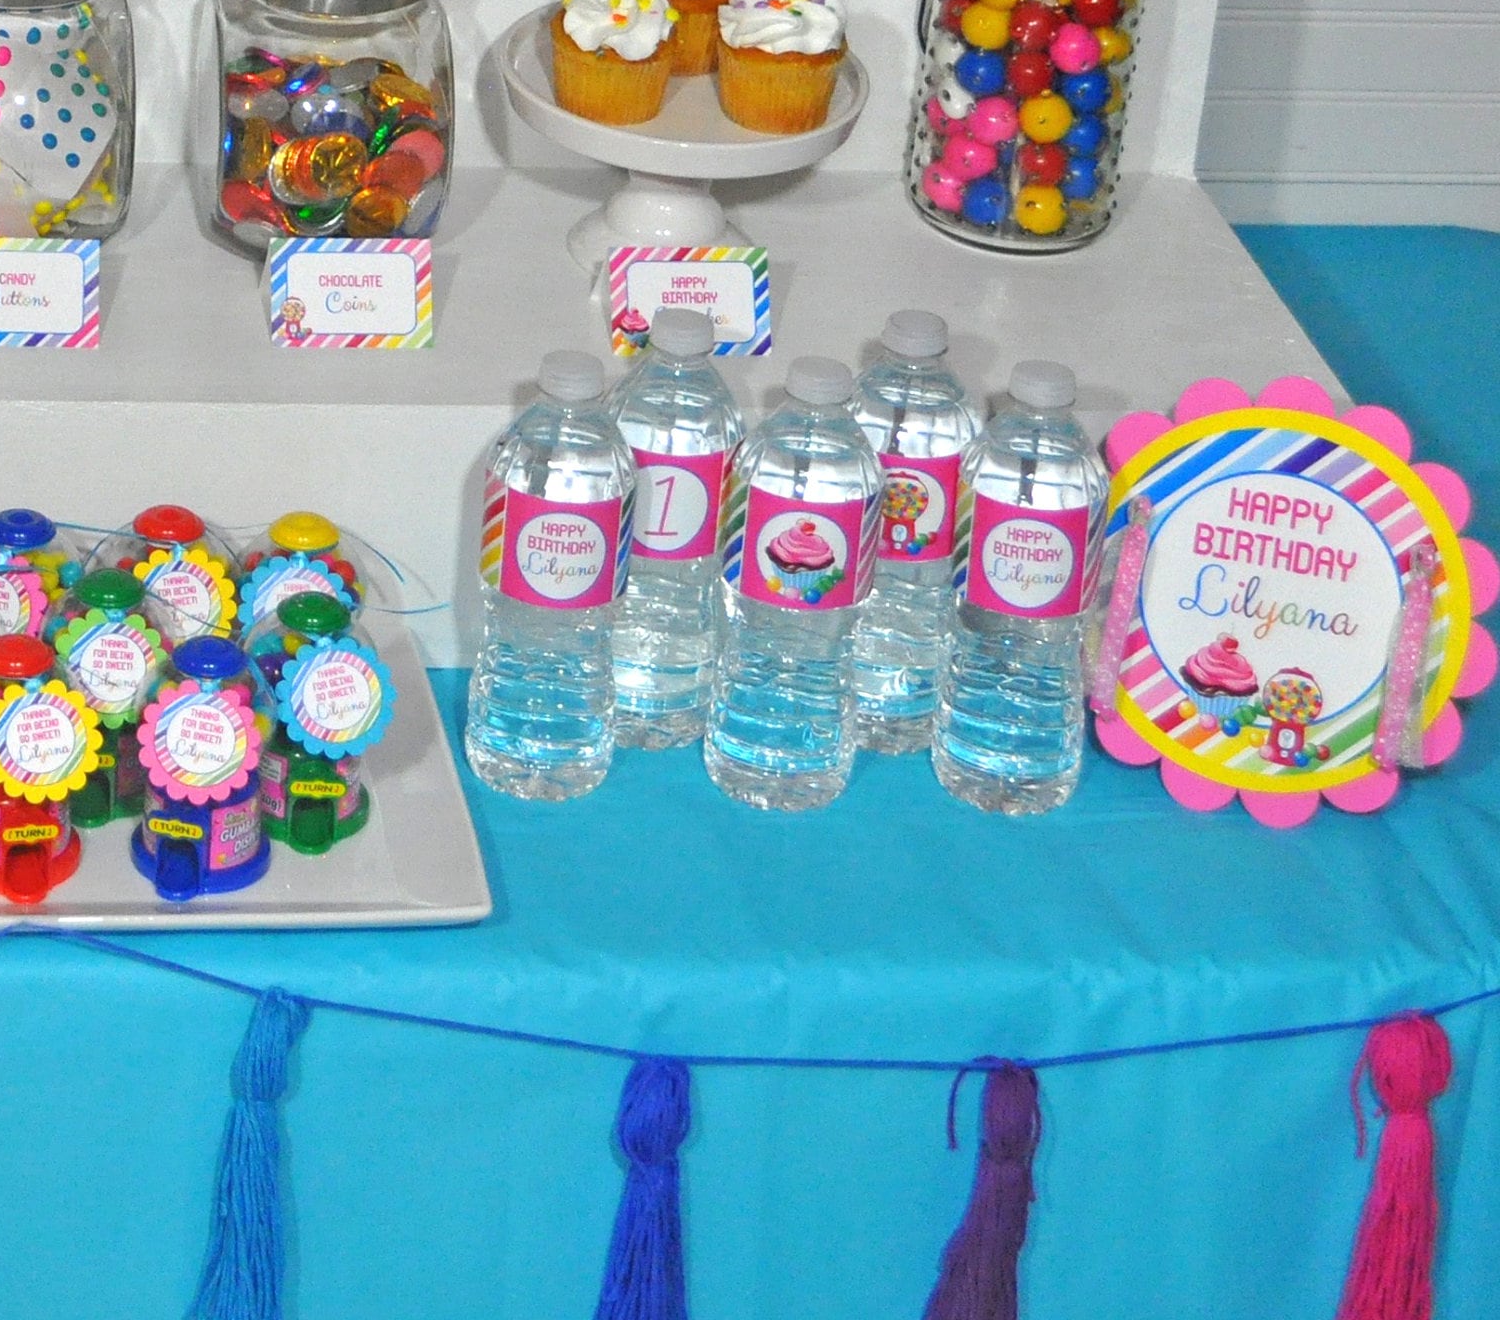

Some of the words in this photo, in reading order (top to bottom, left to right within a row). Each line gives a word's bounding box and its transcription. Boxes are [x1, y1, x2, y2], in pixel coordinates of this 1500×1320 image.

[0, 273, 36, 286] CANDY
[318, 275, 383, 287] CHOCOLATE
[671, 277, 707, 289] HAPPY
[325, 291, 376, 314] Coins
[661, 292, 718, 304] BIRTHDAY
[644, 475, 678, 536] 1
[1228, 486, 1334, 535] HAPPY
[541, 521, 587, 536] HAPPY
[1007, 526, 1052, 544] HAPPY
[527, 535, 596, 556] BIRTHDAY
[993, 543, 1063, 562] BIRTHDAY
[1192, 522, 1357, 582] BIRTHDAY
[522, 552, 599, 582] Lilyana
[987, 558, 1064, 590] Lilyana
[1178, 564, 1359, 640] Lilyana
[303, 784, 333, 792] TURN
[14, 829, 46, 838] TURN
[160, 822, 190, 834] TURN
